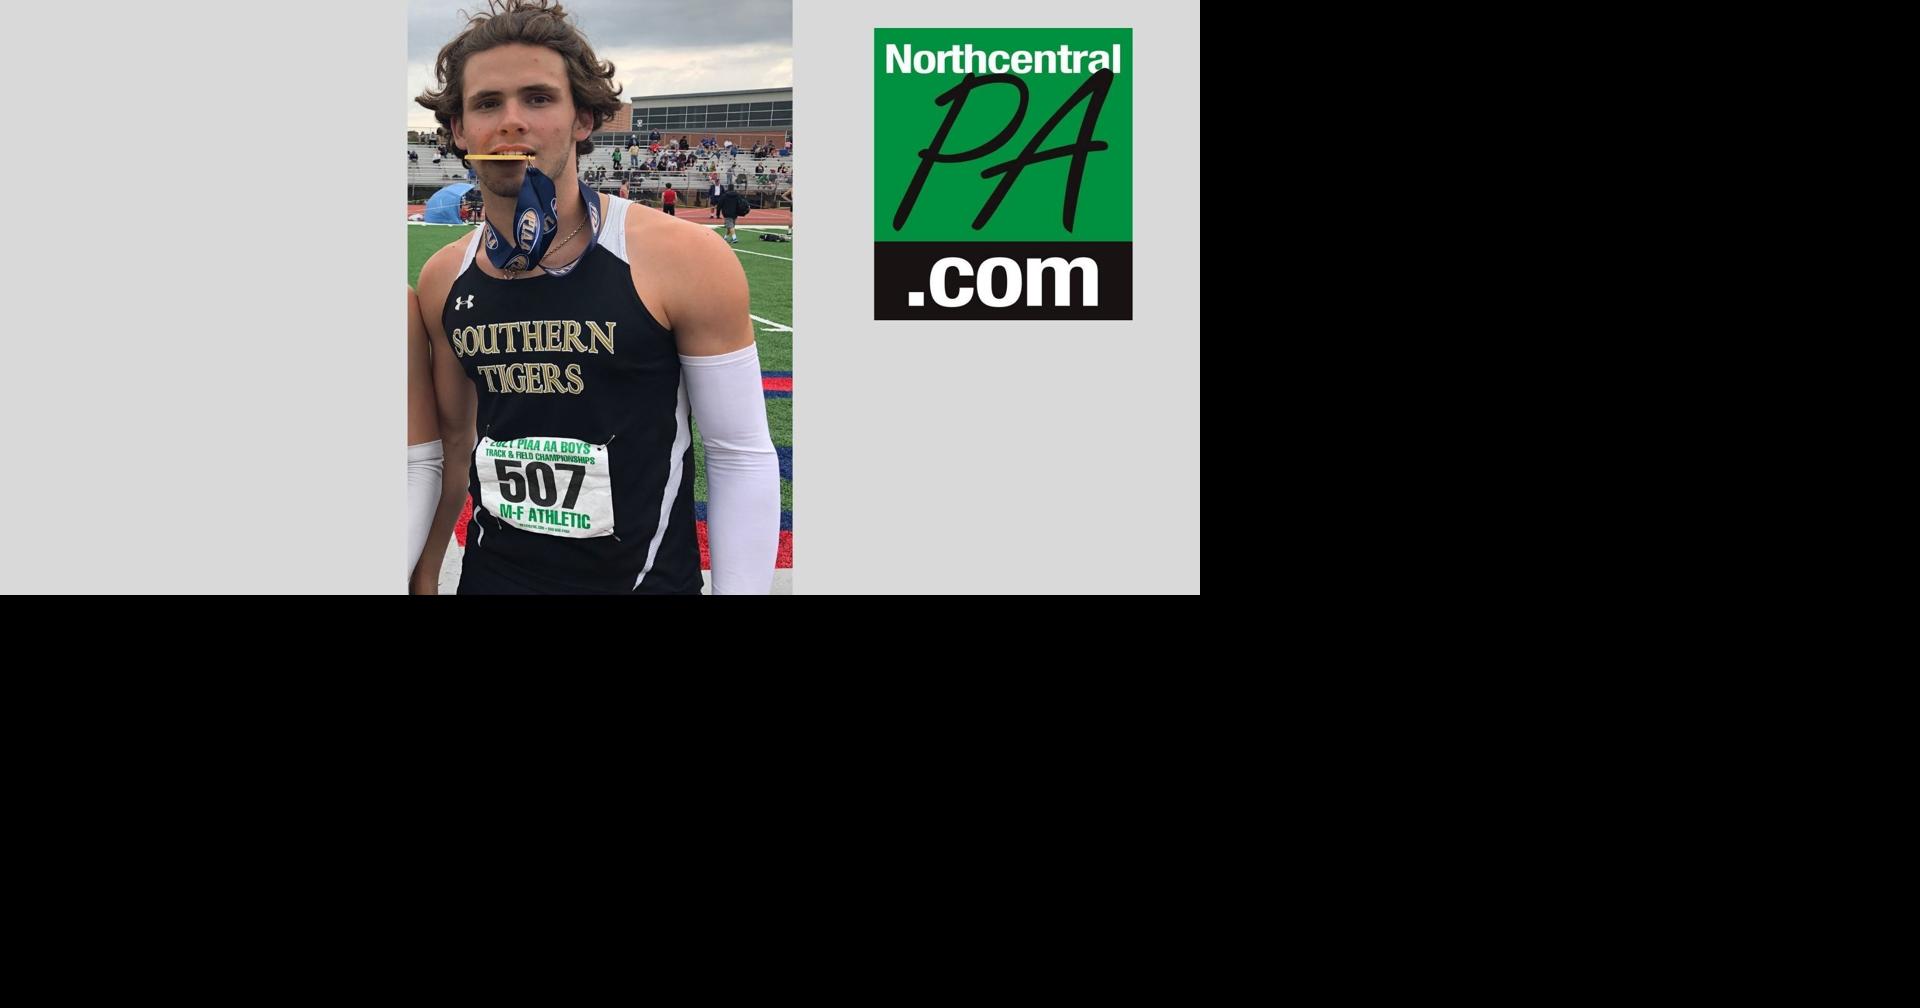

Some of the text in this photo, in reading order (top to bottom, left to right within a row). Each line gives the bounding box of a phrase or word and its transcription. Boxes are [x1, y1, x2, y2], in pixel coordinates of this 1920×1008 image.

[452, 320, 617, 358] SOUTHERN
[477, 362, 585, 395] TIGERS
[485, 448, 596, 465] TRACK & FIELD CHAMPIONSHIPS
[517, 439, 540, 451] PIAA
[544, 440, 558, 452] AA
[561, 441, 591, 455] BOYS
[494, 459, 586, 510] 507
[500, 503, 524, 520] M-F
[528, 508, 591, 529] ATHLETIC
